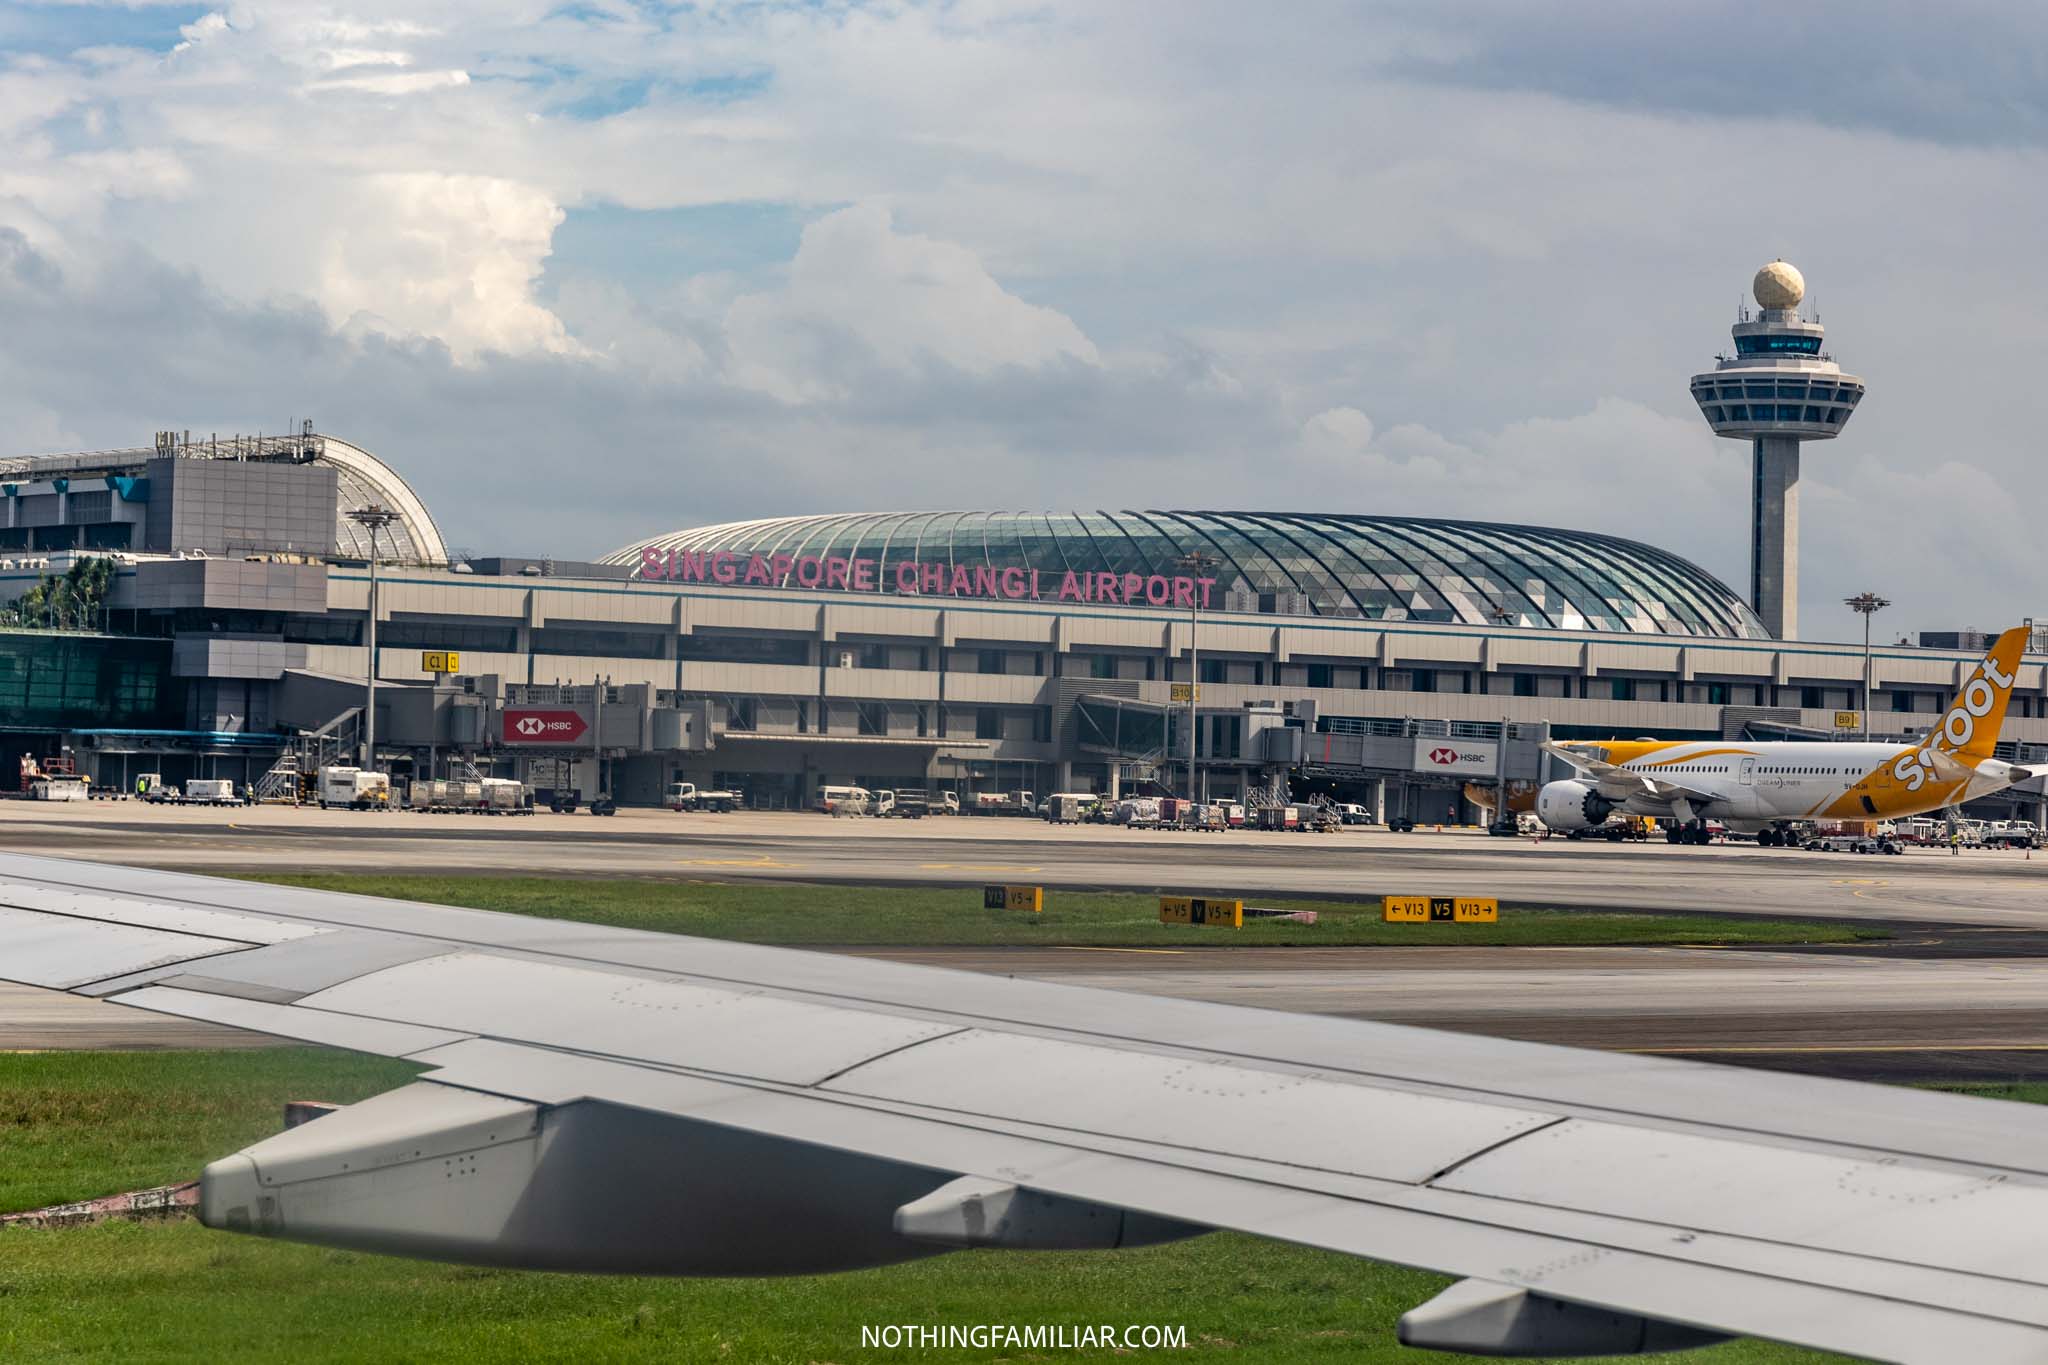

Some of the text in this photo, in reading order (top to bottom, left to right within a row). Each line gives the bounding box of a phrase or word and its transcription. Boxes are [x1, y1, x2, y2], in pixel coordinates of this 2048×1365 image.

[641, 547, 1217, 608] SINGAPORE CHANGI AIRPORT
[429, 655, 440, 668] C1
[1172, 687, 1190, 698] B10
[547, 721, 572, 731] HSBC
[1460, 753, 1486, 763] HSBC
[1010, 892, 1023, 905] V5
[1174, 904, 1187, 917] V5
[1208, 905, 1222, 919] V5
[1404, 903, 1481, 917] V13 V5 V13
